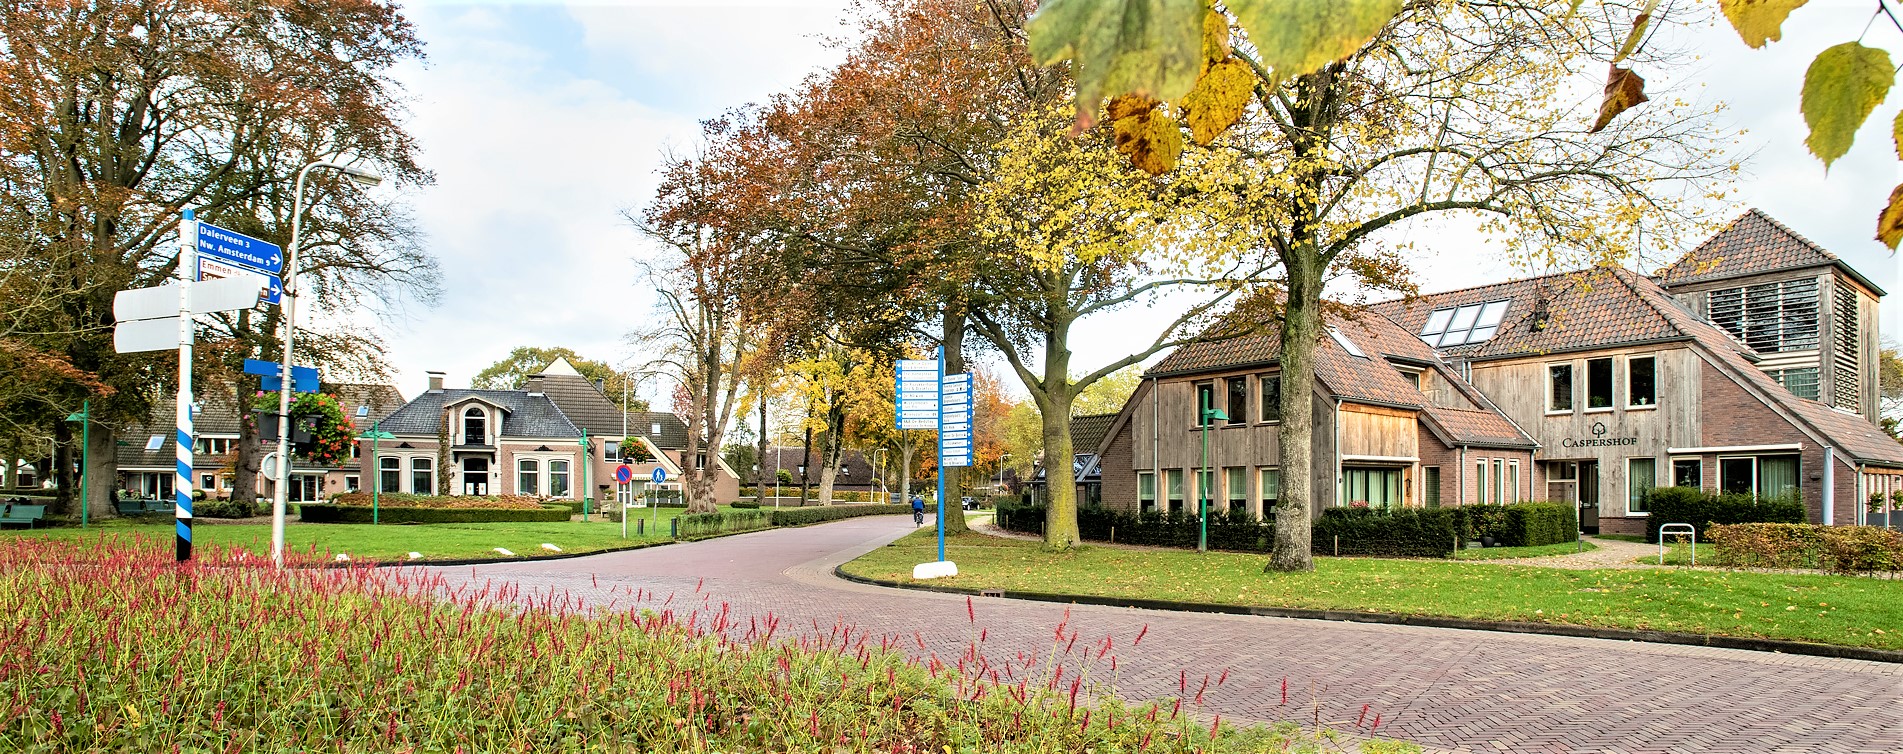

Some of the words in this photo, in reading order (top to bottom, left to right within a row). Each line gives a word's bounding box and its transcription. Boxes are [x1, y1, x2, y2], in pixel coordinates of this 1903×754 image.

[200, 226, 244, 246] Dalerveen
[245, 241, 251, 249] 3
[200, 239, 216, 251] Nw.
[218, 244, 264, 265] Amsterdam
[202, 260, 232, 275] Emmen
[1562, 438, 1637, 448] CASPERSHOF
